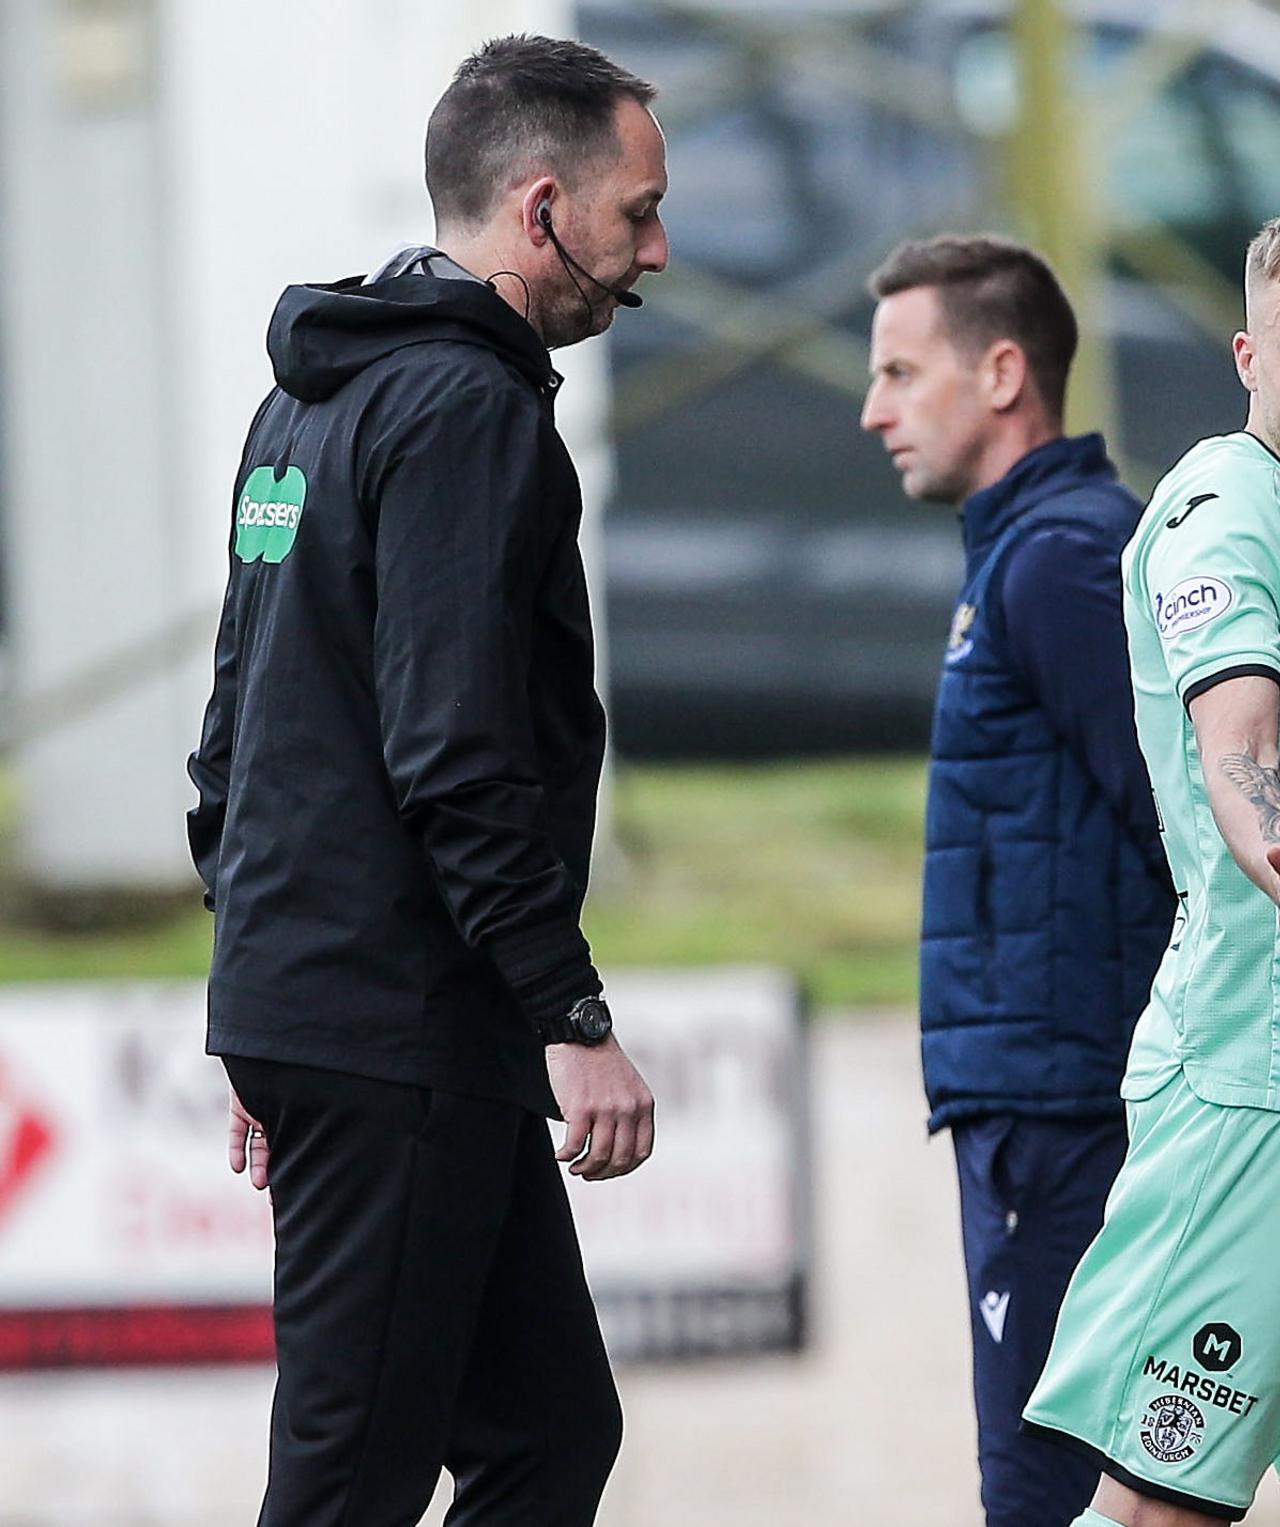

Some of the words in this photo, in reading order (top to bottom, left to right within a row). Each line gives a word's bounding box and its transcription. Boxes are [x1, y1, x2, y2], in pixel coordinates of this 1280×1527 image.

[1164, 584, 1217, 620] cinch
[1202, 1332, 1232, 1363] M
[1143, 1355, 1259, 1417] MARSBET
[1151, 1396, 1203, 1427] HIBERNIAN
[1141, 1435, 1191, 1462] EDINBURGH
